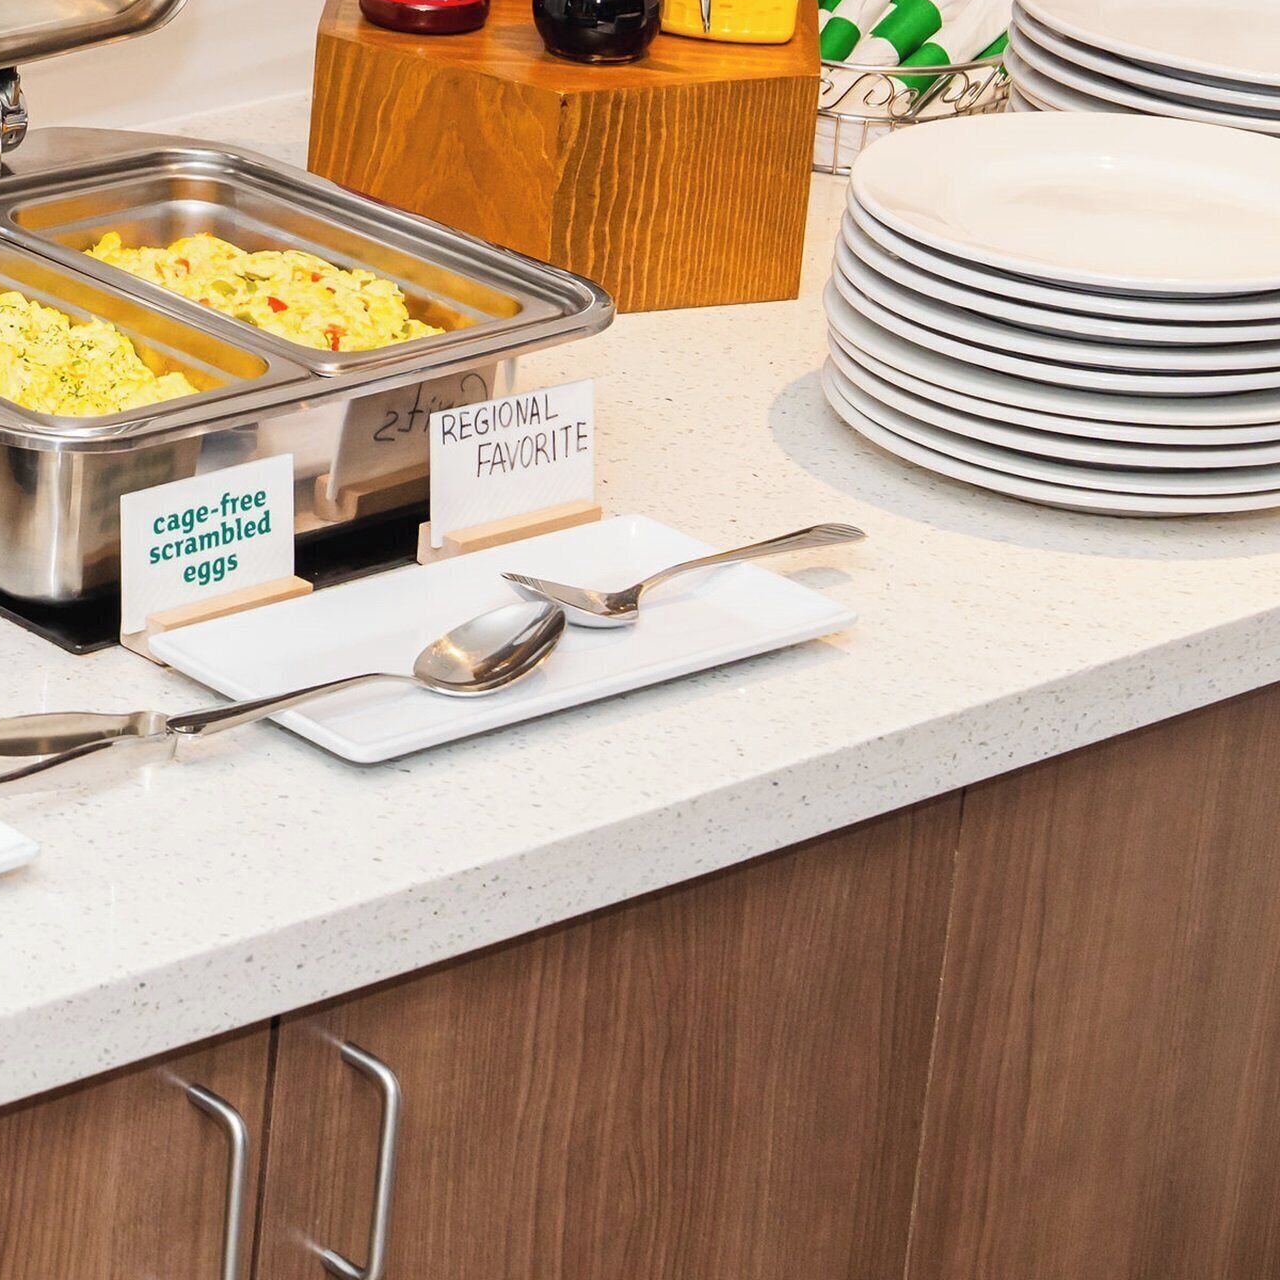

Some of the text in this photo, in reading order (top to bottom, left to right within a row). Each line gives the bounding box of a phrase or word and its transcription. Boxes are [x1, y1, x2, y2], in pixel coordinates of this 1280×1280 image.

[441, 393, 559, 445] REGIONAL
[477, 421, 588, 477] FAVORITE
[148, 509, 272, 564] scrambled
[152, 488, 268, 536] cage-free
[182, 554, 239, 586] eggs
